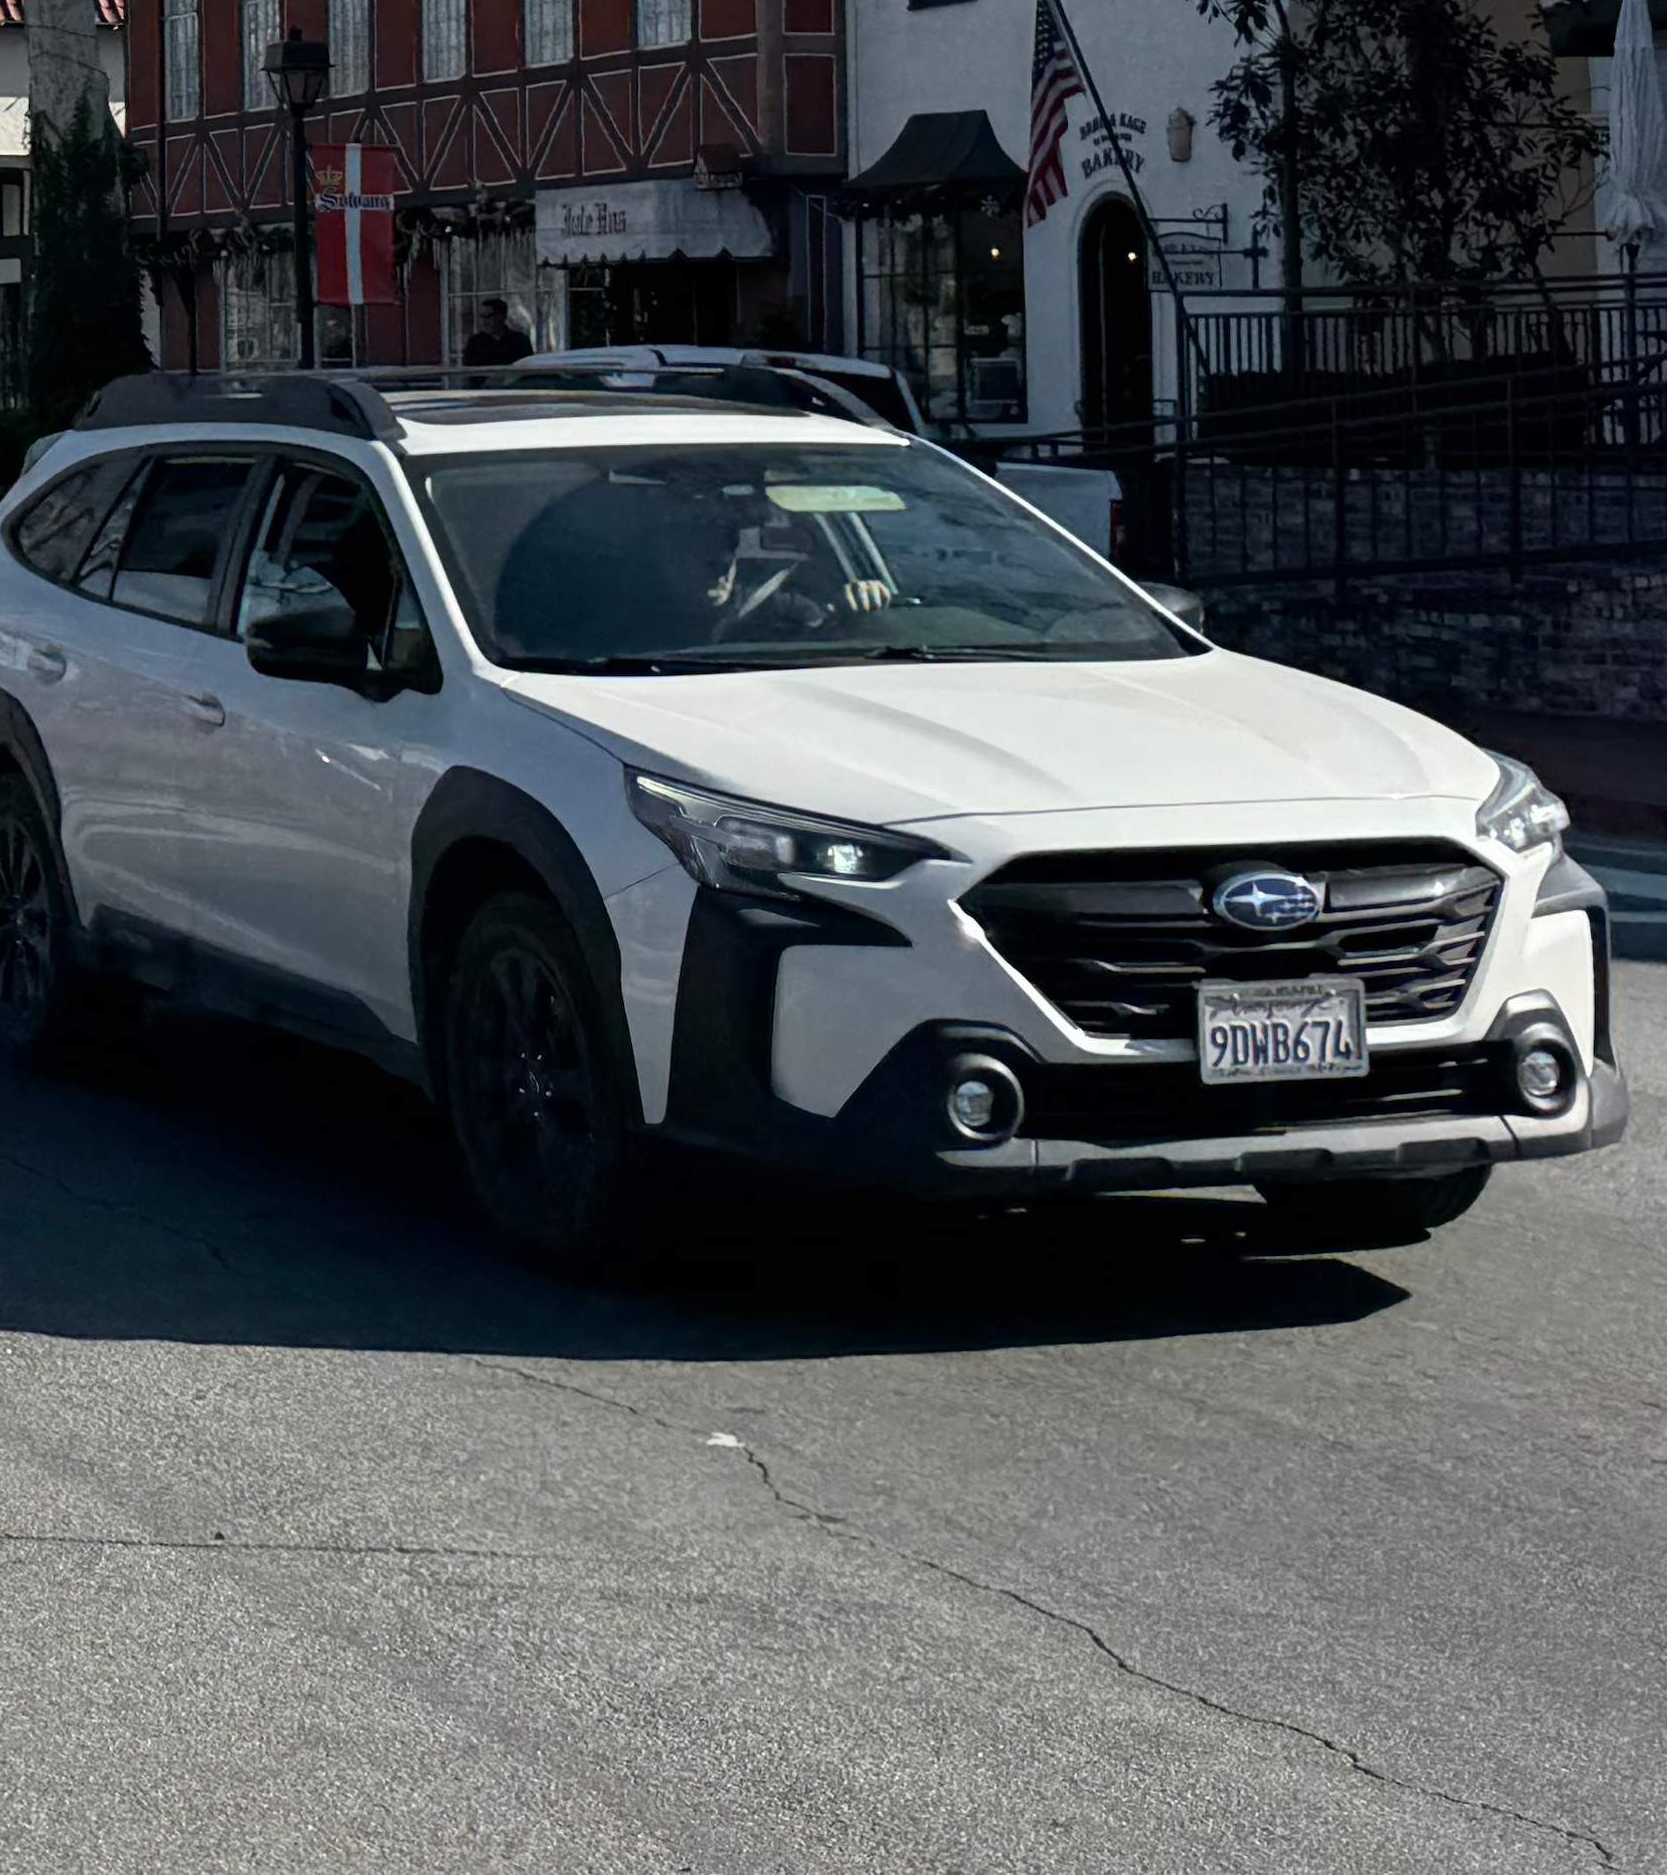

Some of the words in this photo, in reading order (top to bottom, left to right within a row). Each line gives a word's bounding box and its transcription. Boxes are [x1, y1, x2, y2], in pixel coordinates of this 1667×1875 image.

[318, 186, 390, 211] Solvang
[1151, 270, 1215, 287] BKERY
[1210, 1020, 1353, 1068] 9DWB674
